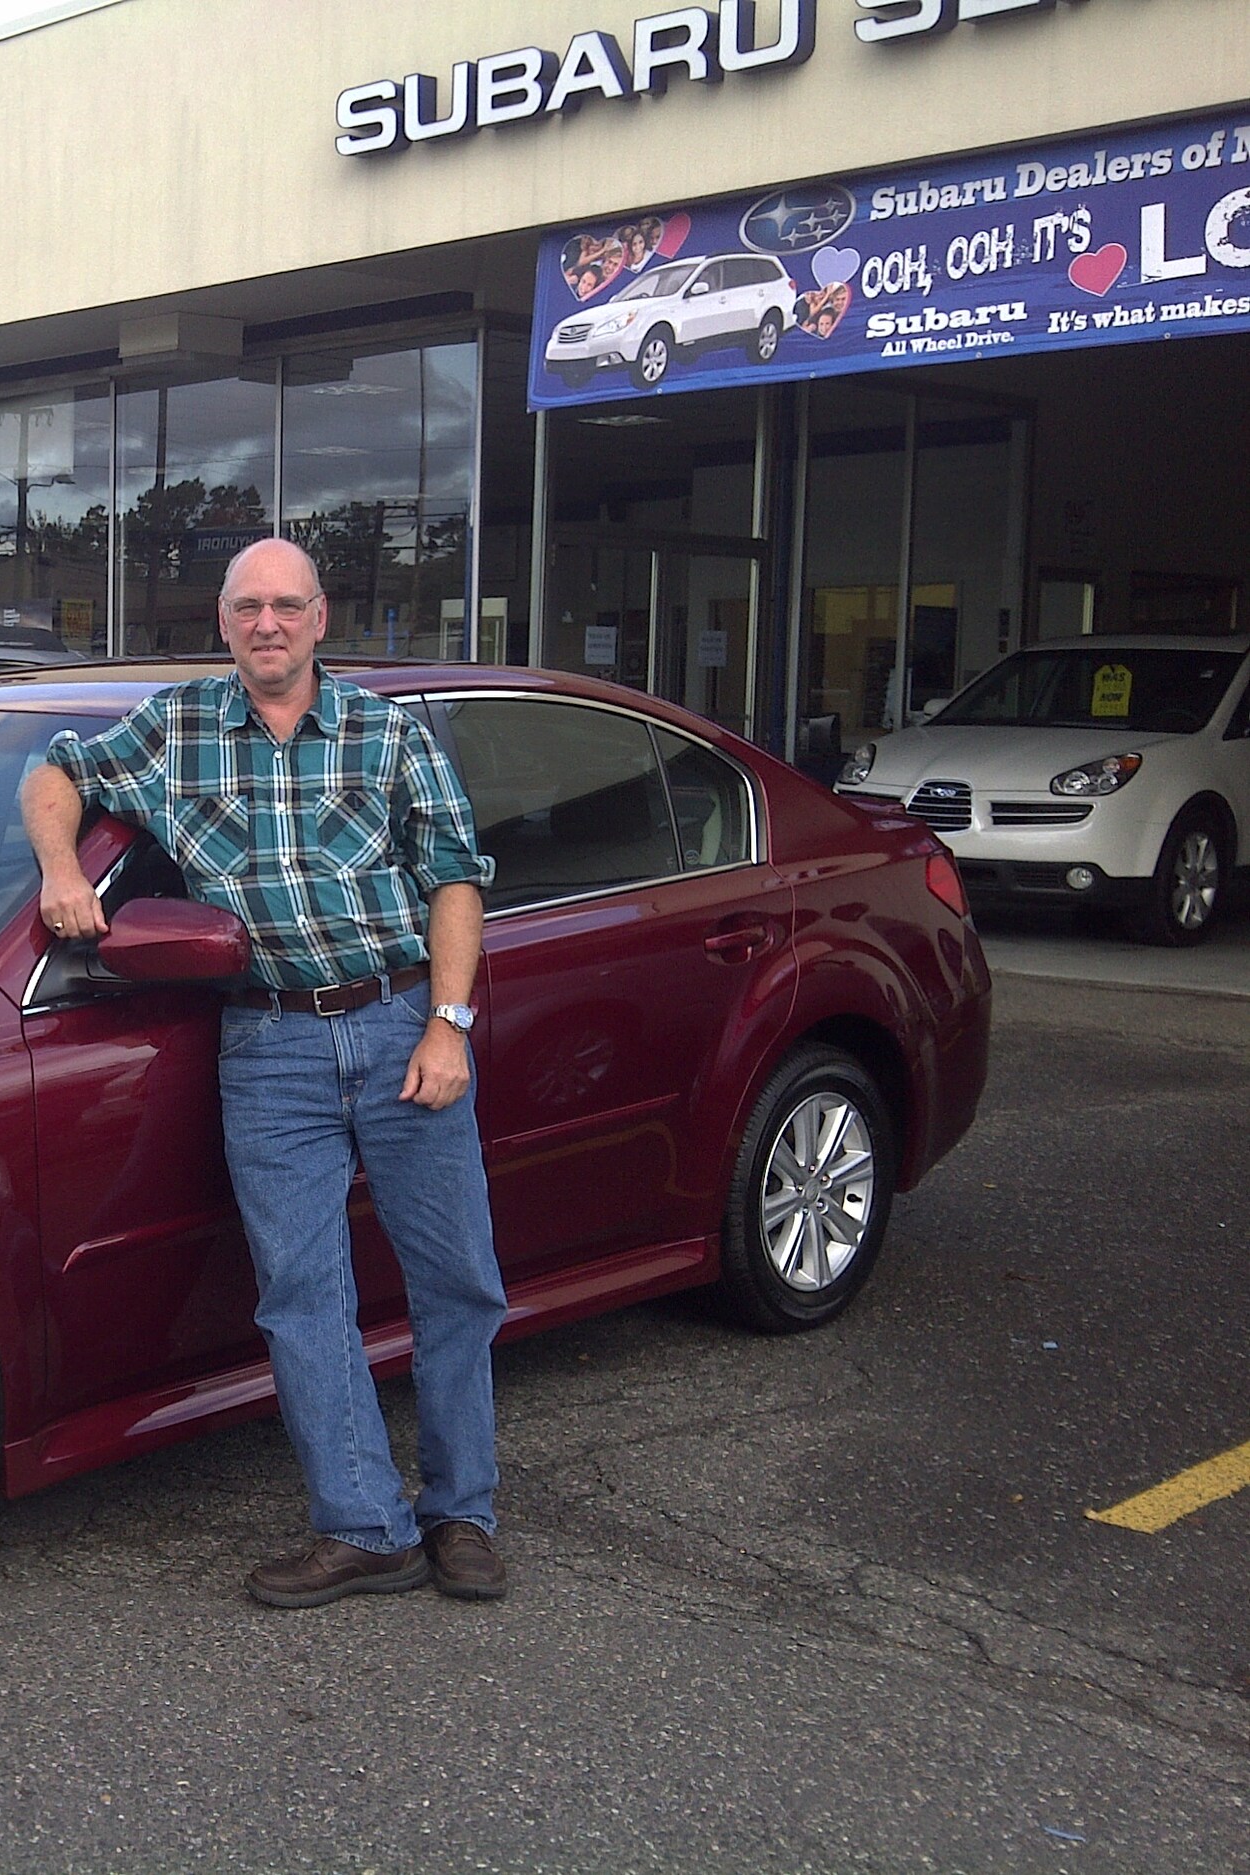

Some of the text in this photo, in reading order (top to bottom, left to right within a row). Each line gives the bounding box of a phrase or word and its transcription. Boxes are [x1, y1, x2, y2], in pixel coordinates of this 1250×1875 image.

[335, 0, 803, 157] SUBARU
[870, 177, 1007, 221] Subaru
[1014, 150, 1173, 198] Dealers
[1181, 129, 1226, 171] of
[947, 224, 1014, 281] OOH
[1033, 203, 1092, 263] IT'S
[866, 295, 1250, 339] Subaru It's what makes
[881, 331, 1014, 357] All Wheel Drive.
